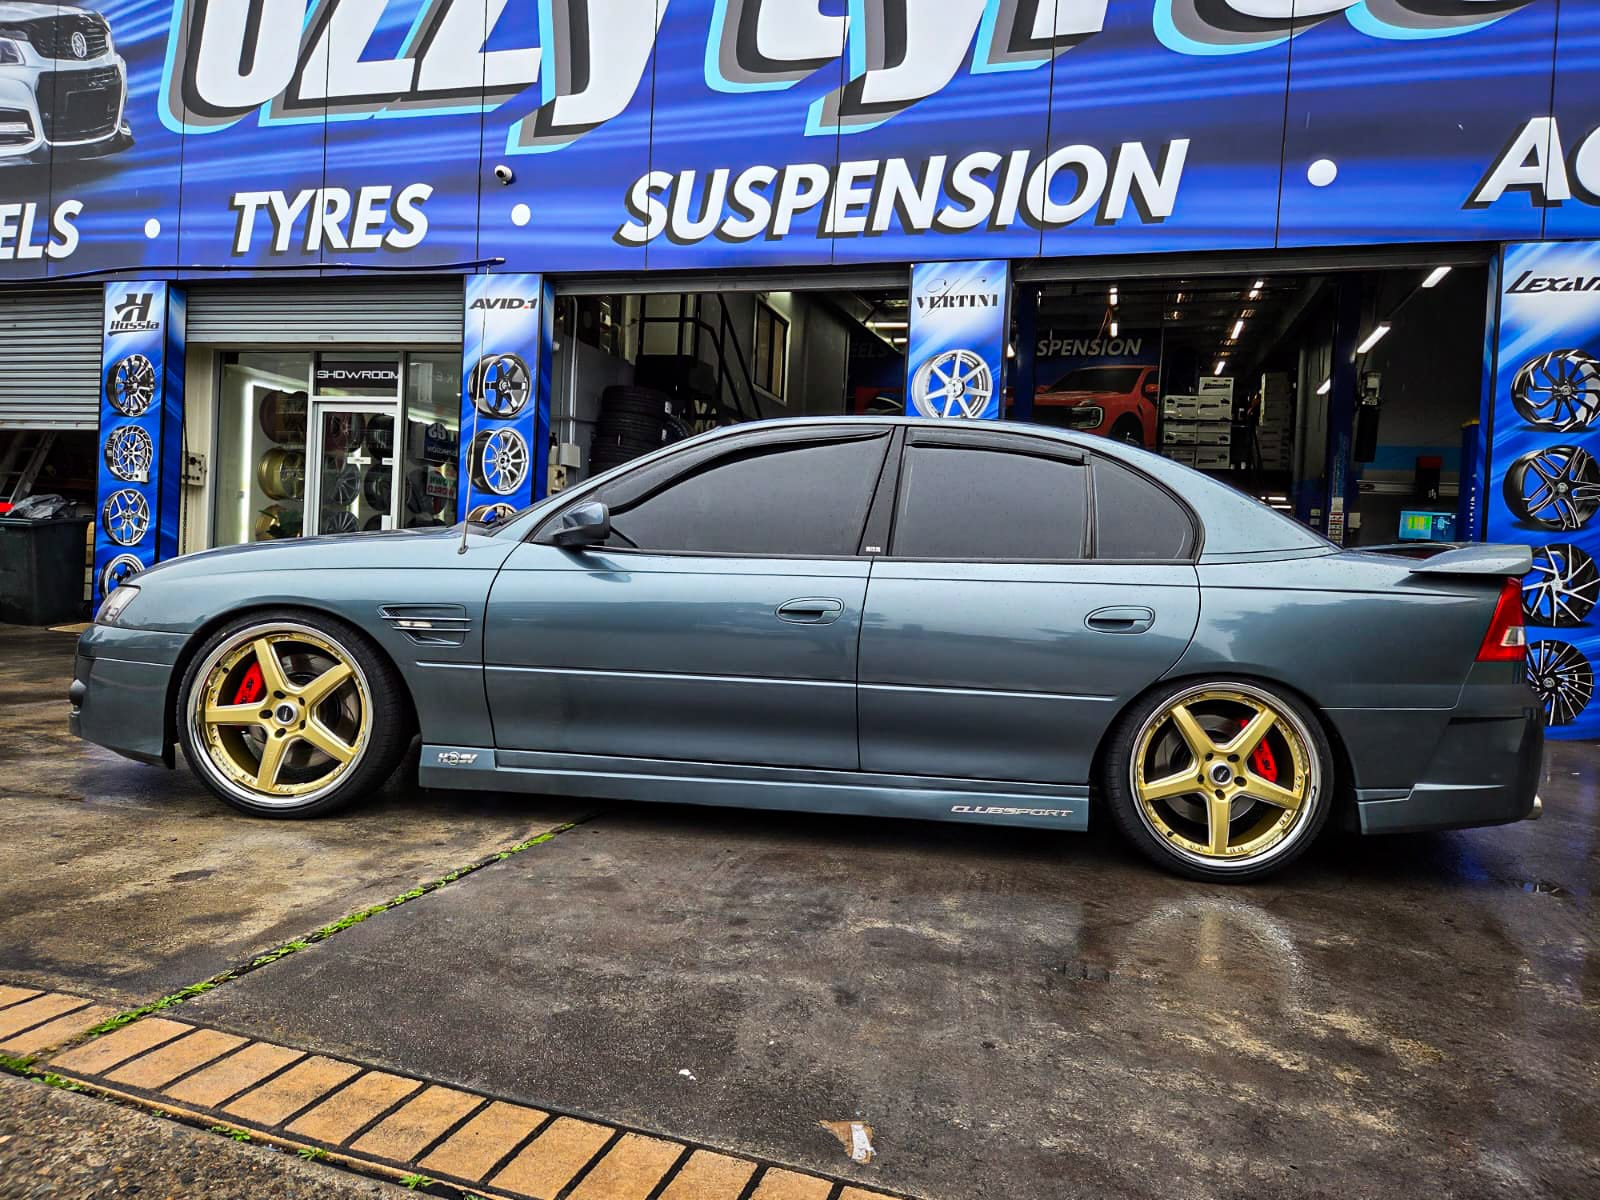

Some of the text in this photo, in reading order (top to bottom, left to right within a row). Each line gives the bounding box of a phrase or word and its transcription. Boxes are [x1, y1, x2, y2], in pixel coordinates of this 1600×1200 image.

[231, 183, 433, 255] TYRES
[615, 139, 1190, 245] SUSPENSION
[469, 298, 538, 310] AVID.1
[917, 294, 998, 309] VERTINI
[1036, 338, 1142, 357] SPENSION
[951, 805, 1074, 817] CLUBSPORT
